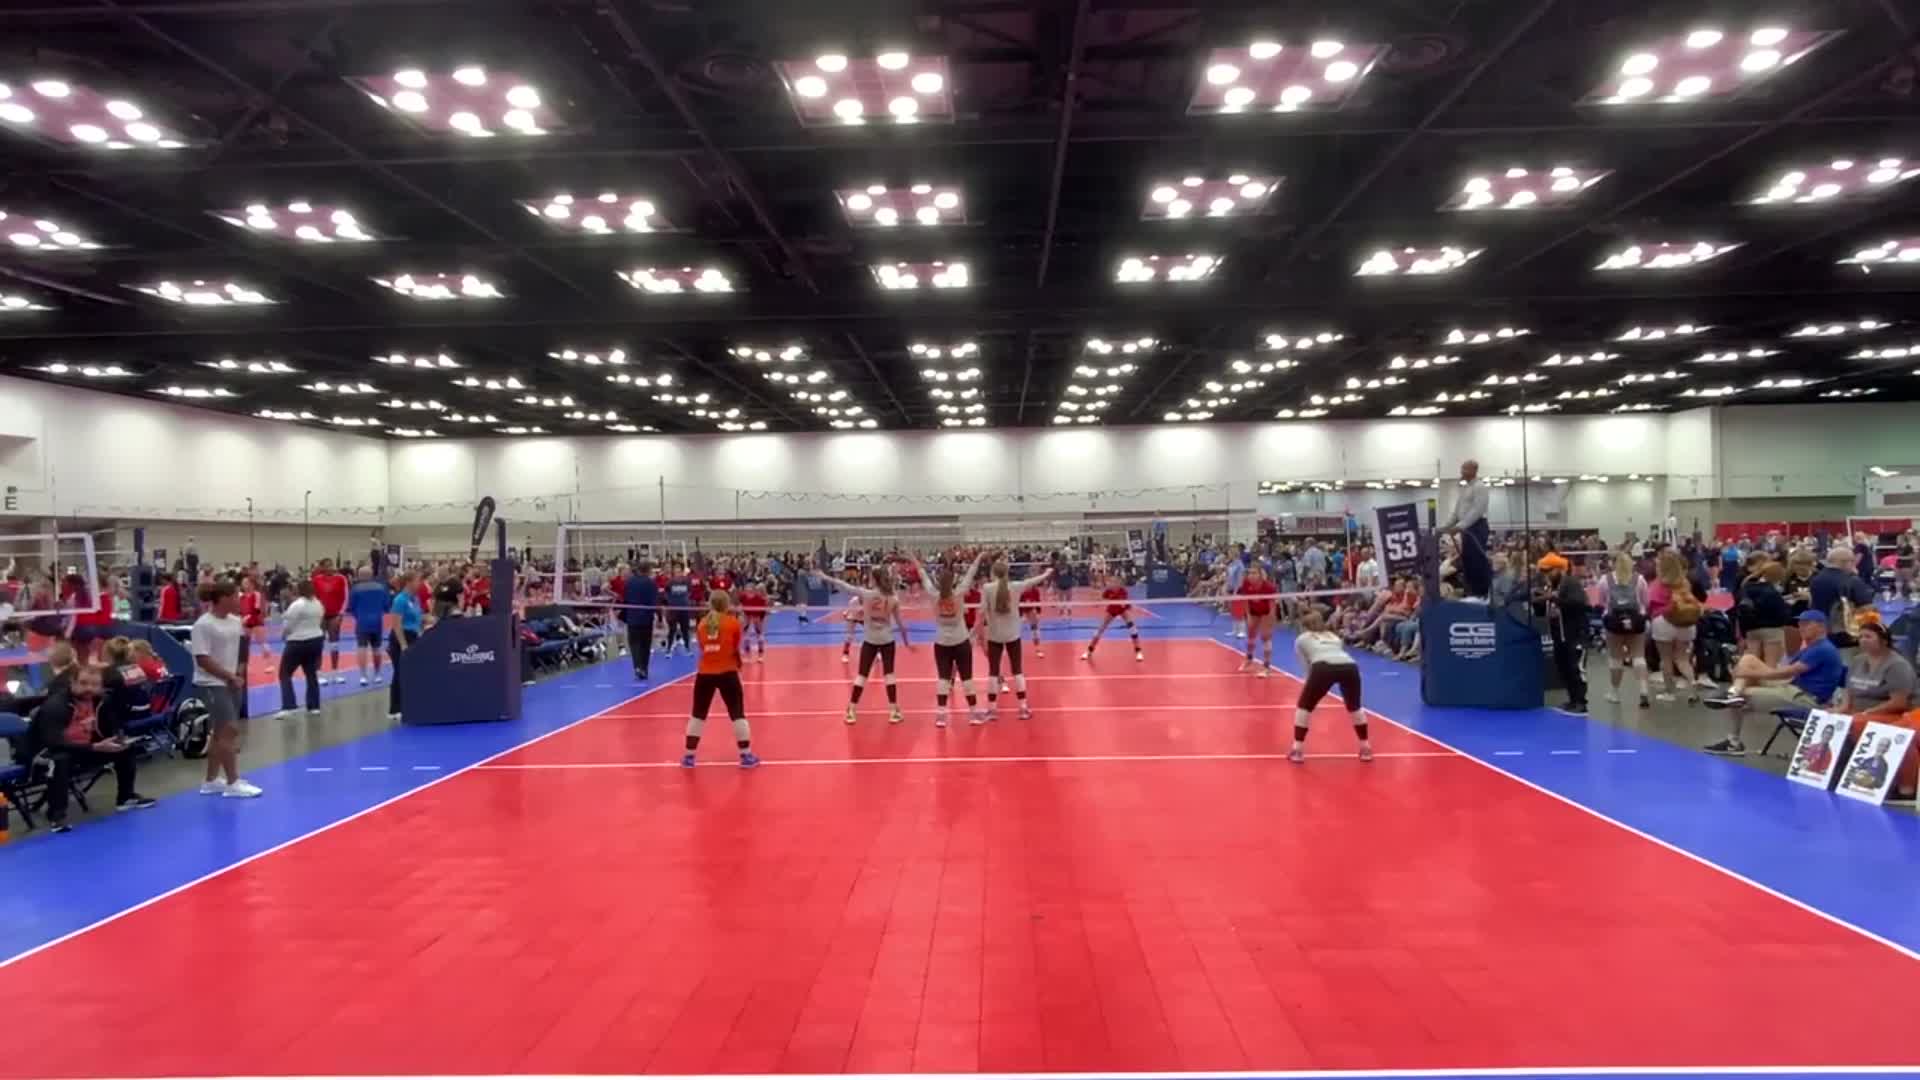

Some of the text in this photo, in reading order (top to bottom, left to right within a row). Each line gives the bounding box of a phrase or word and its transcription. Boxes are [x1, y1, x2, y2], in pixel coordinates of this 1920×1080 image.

[1385, 530, 1417, 560] 53
[450, 650, 495, 664] SPALDING
[1841, 731, 1876, 789] MIKAYLA
